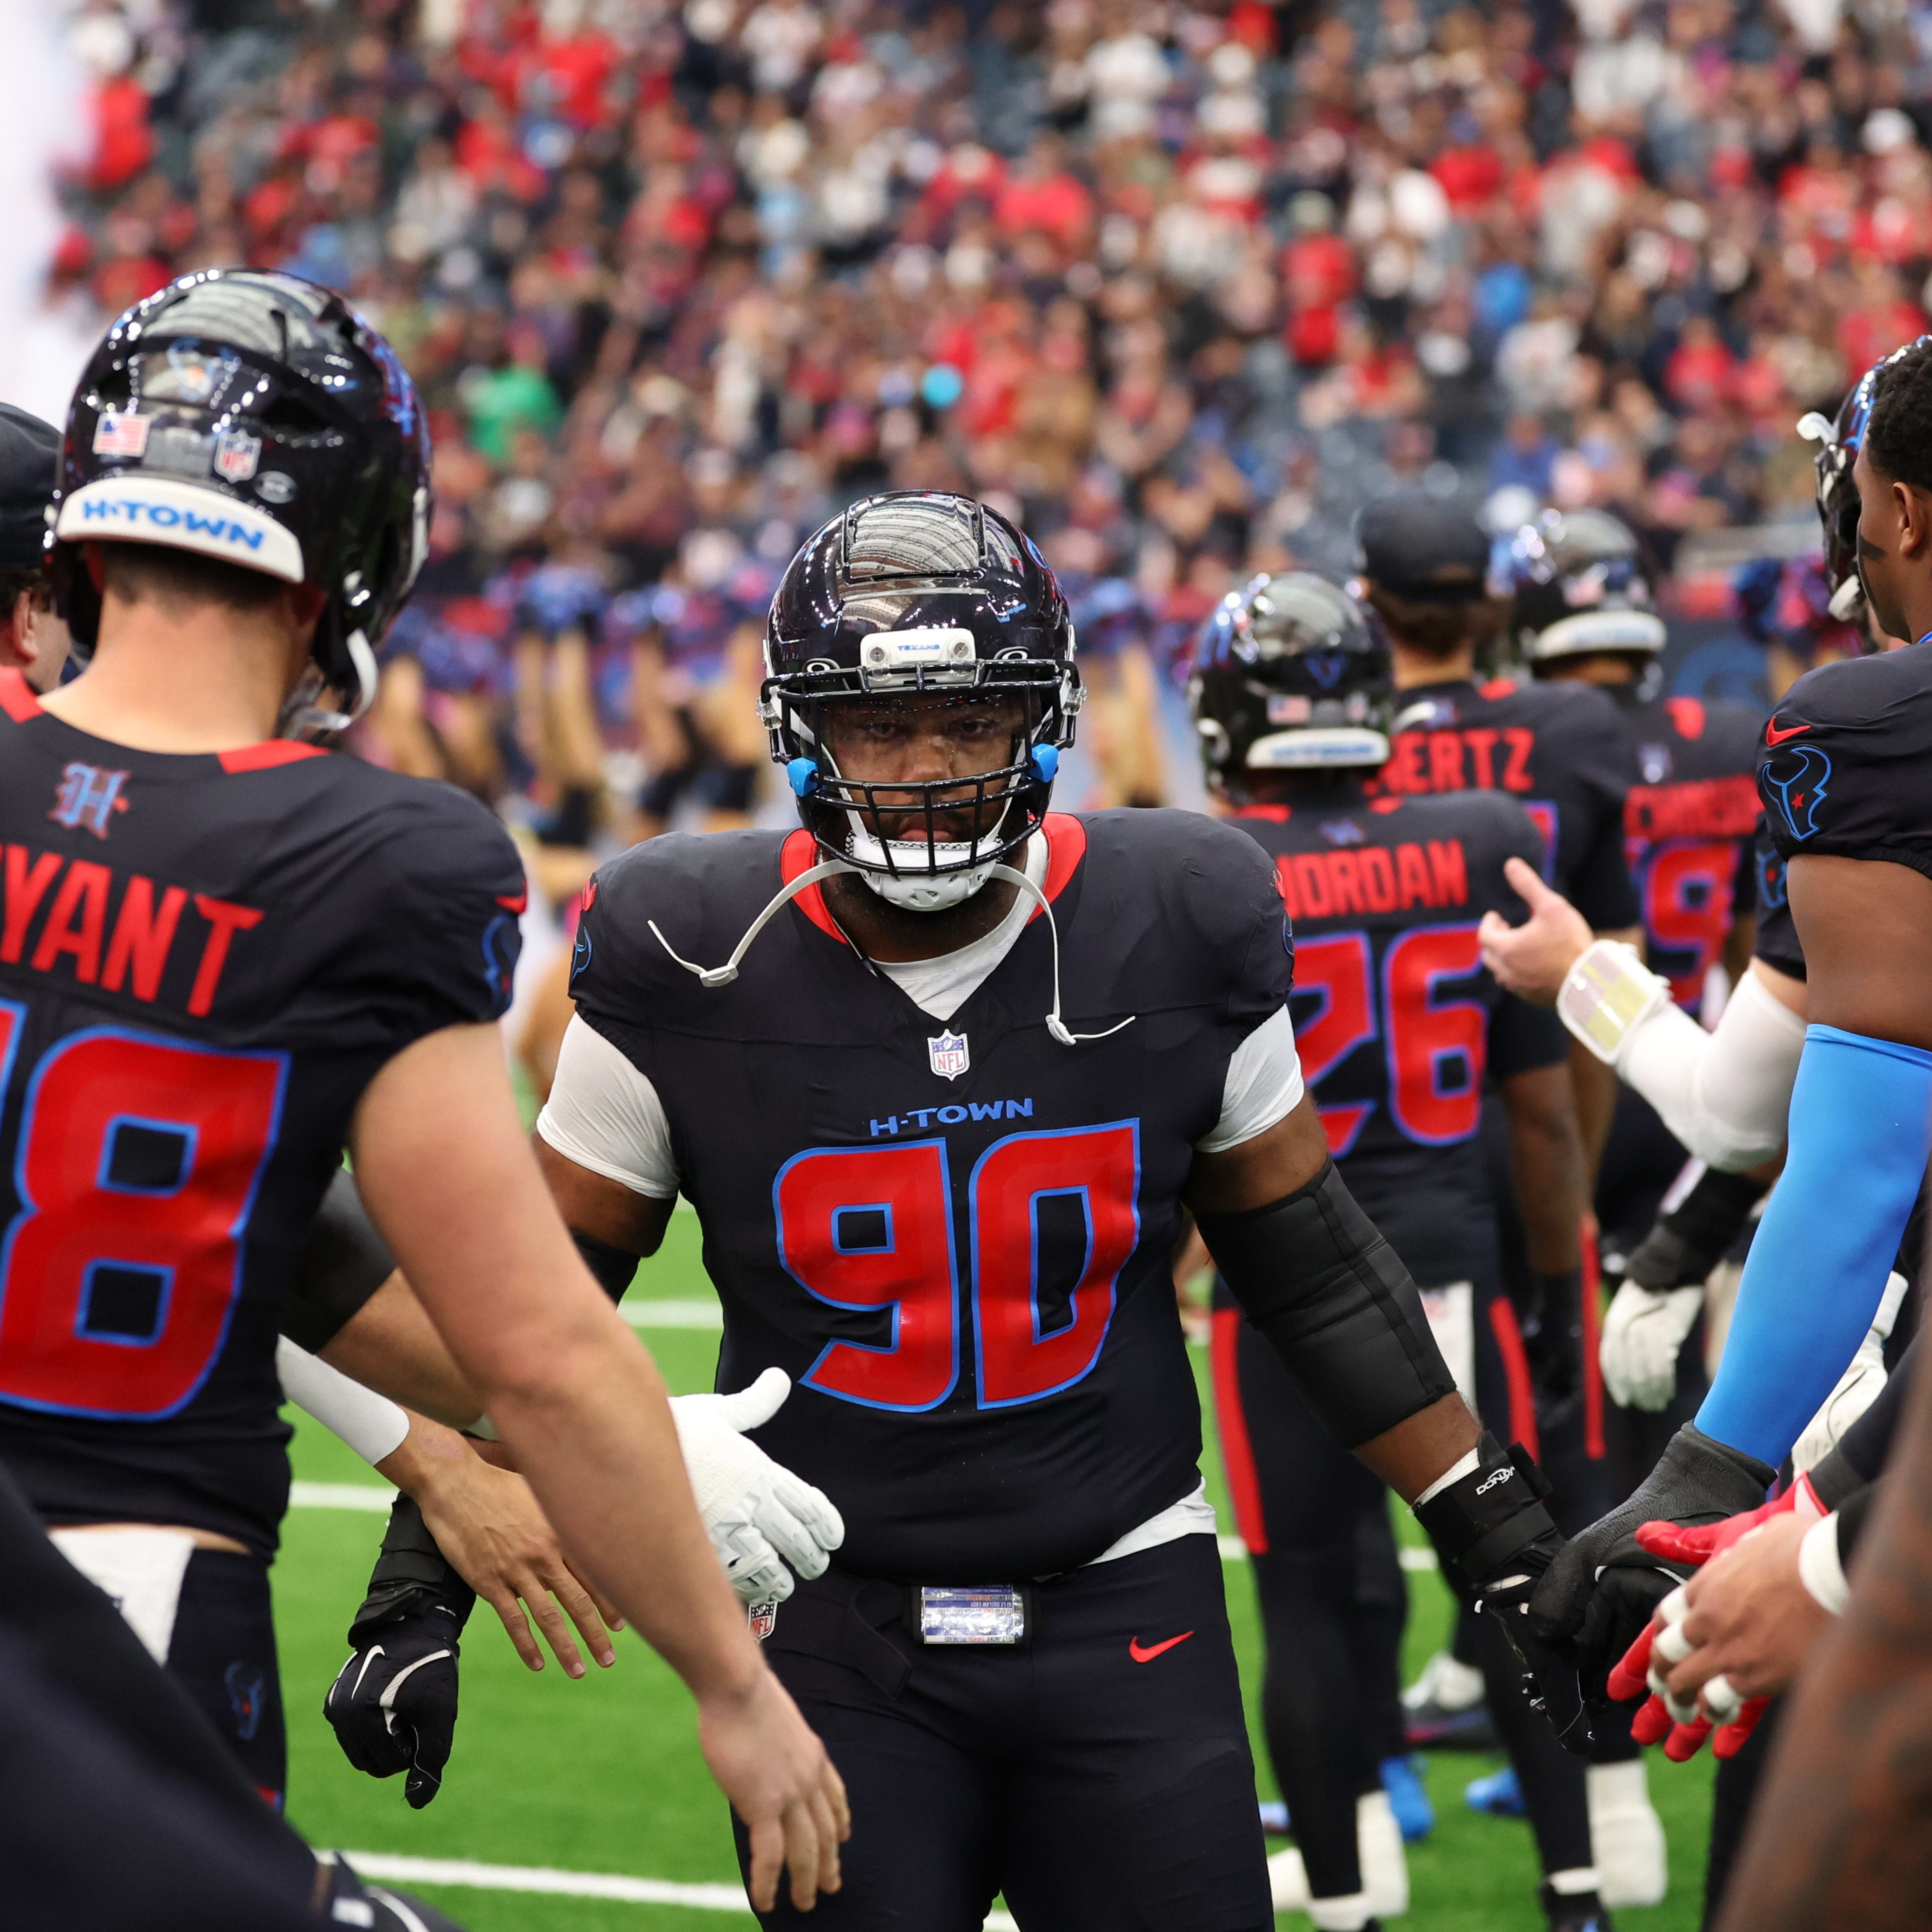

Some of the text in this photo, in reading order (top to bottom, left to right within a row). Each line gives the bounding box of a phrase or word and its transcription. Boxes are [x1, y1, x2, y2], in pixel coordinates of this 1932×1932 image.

[0, 842, 265, 1018] YANT
[869, 1097, 1034, 1137] H-TOWN
[936, 1052, 963, 1071] NFL
[1291, 918, 1489, 1159] 26
[0, 996, 291, 1421] 8
[772, 1117, 1142, 1413] 90
